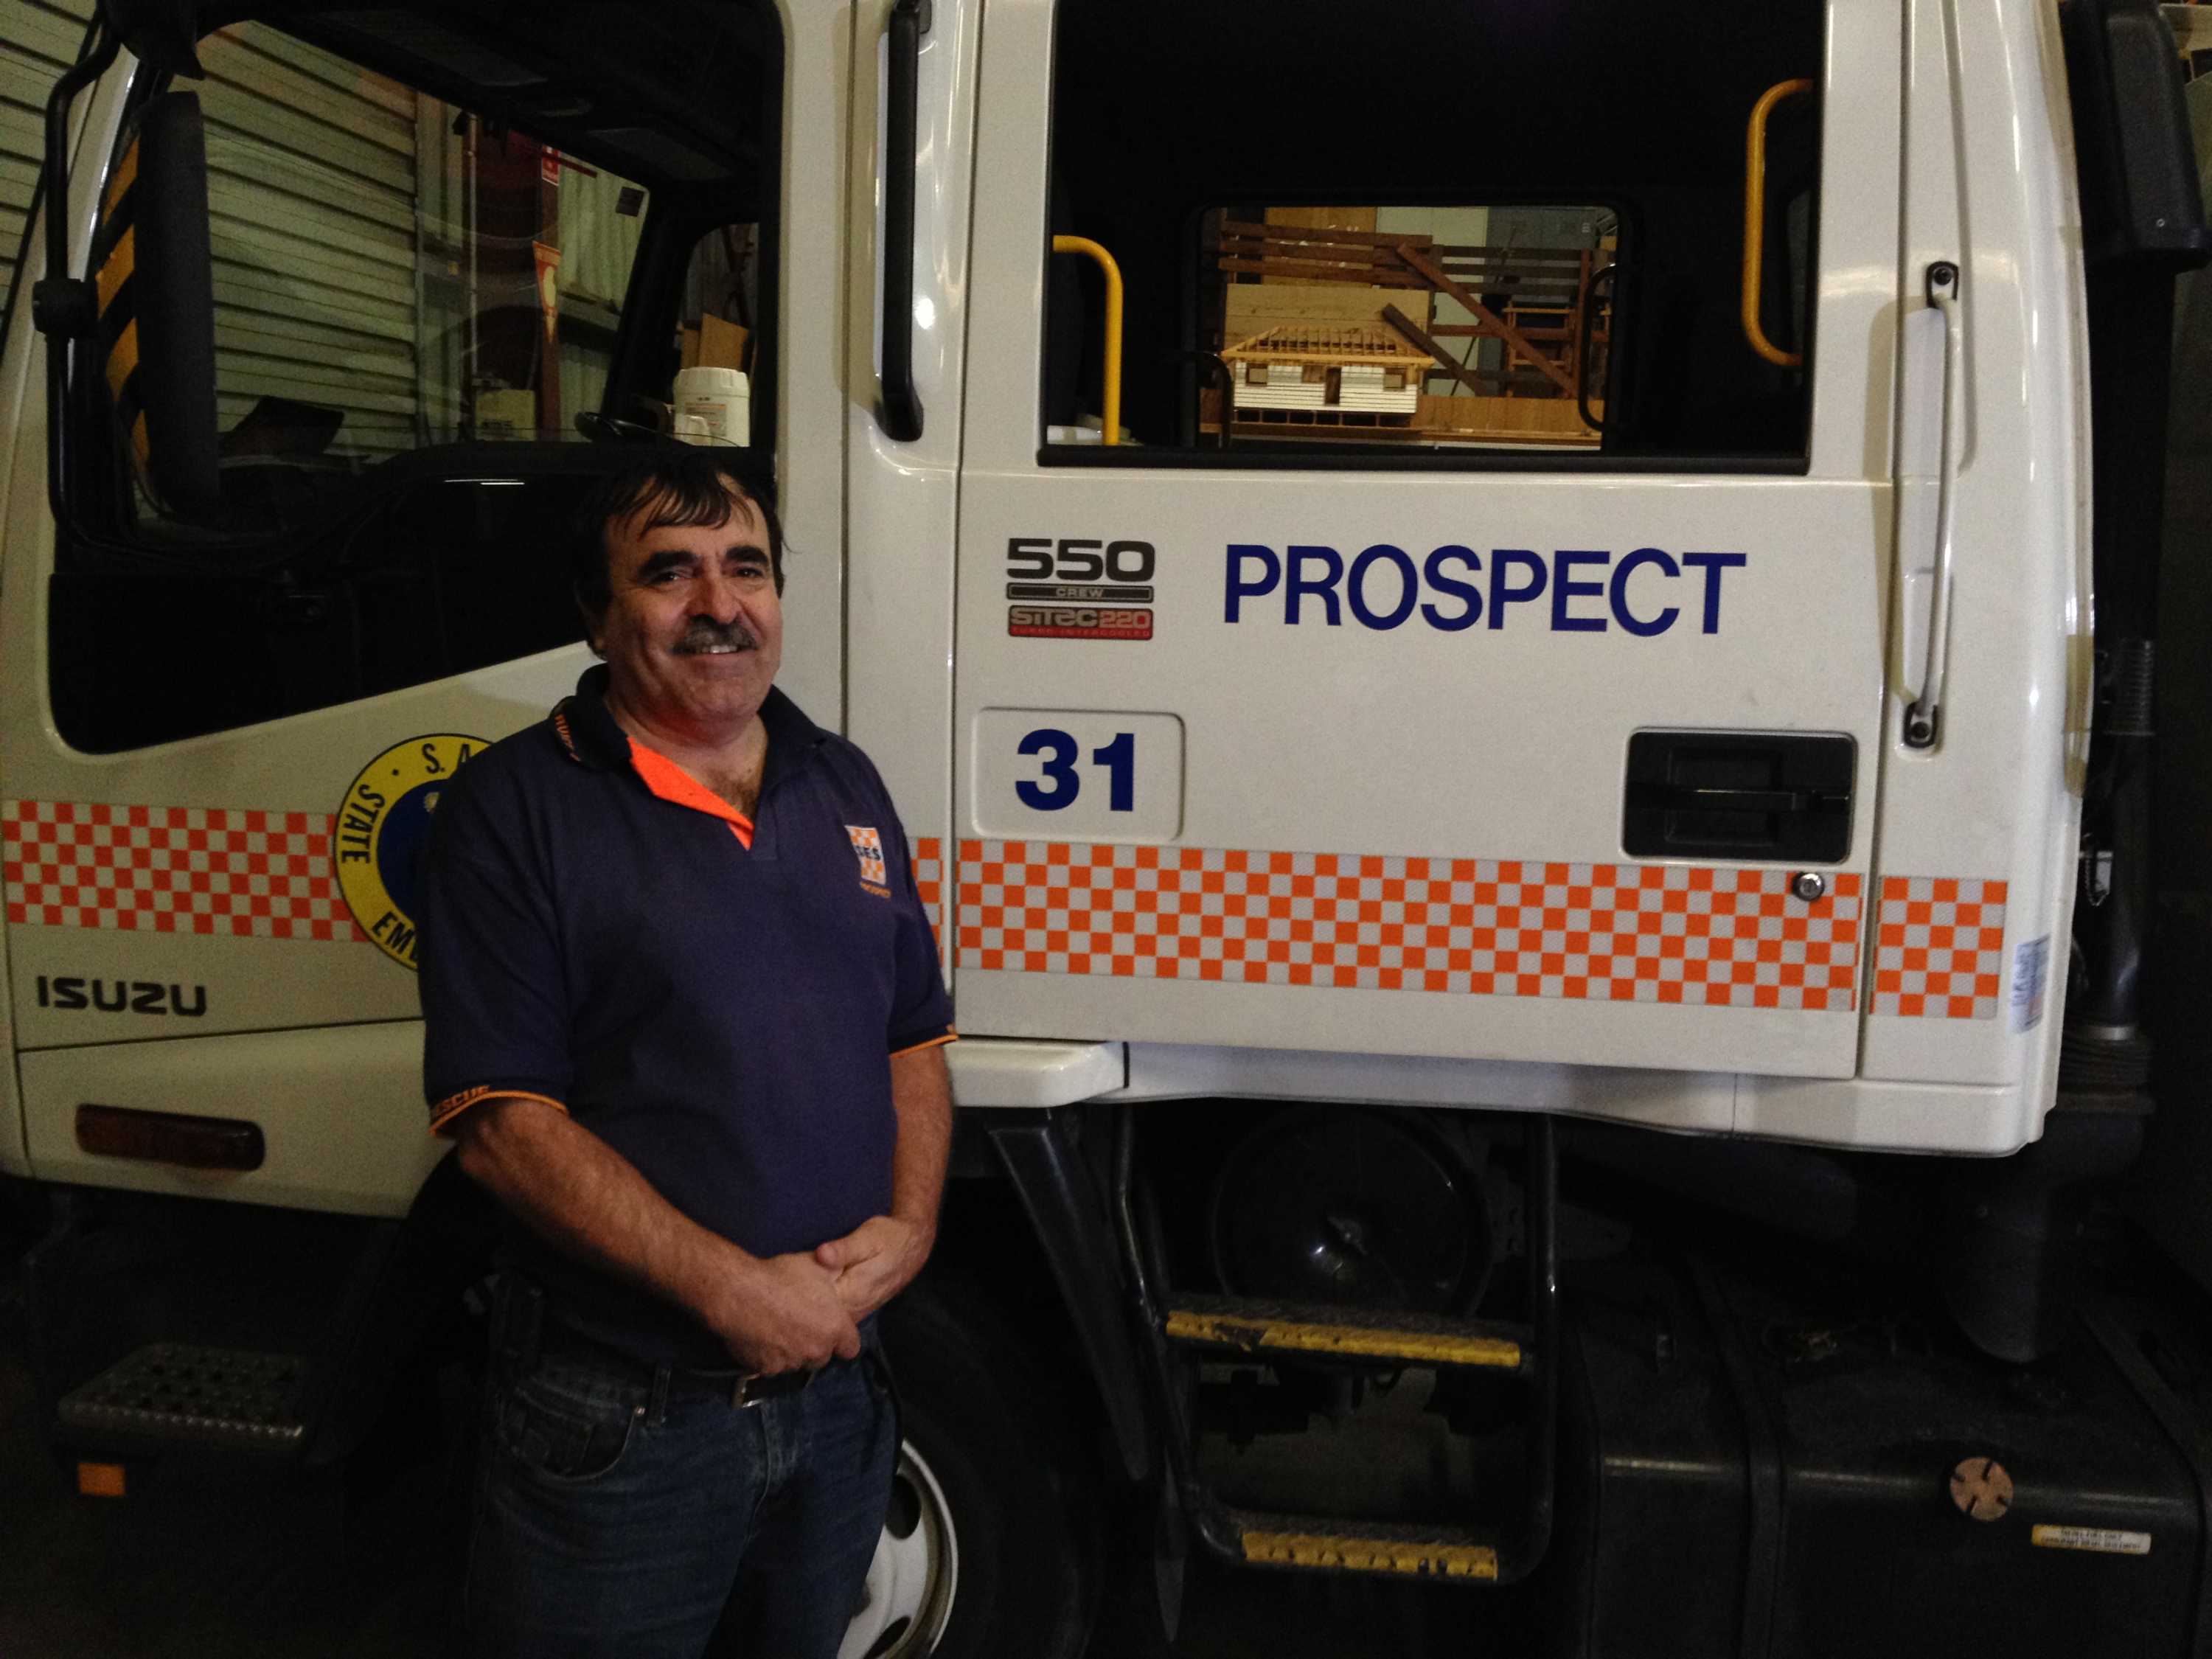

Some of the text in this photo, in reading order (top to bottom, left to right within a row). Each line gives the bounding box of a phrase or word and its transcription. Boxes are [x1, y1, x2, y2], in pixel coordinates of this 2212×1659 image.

[1006, 538, 1155, 582] 550
[1055, 587, 1105, 598] CREW
[1225, 543, 1747, 636] PROSPECT
[1015, 728, 1134, 812] 31
[341, 784, 386, 866] STATE
[372, 911, 419, 961] EM
[36, 975, 208, 1018] ISUZU
